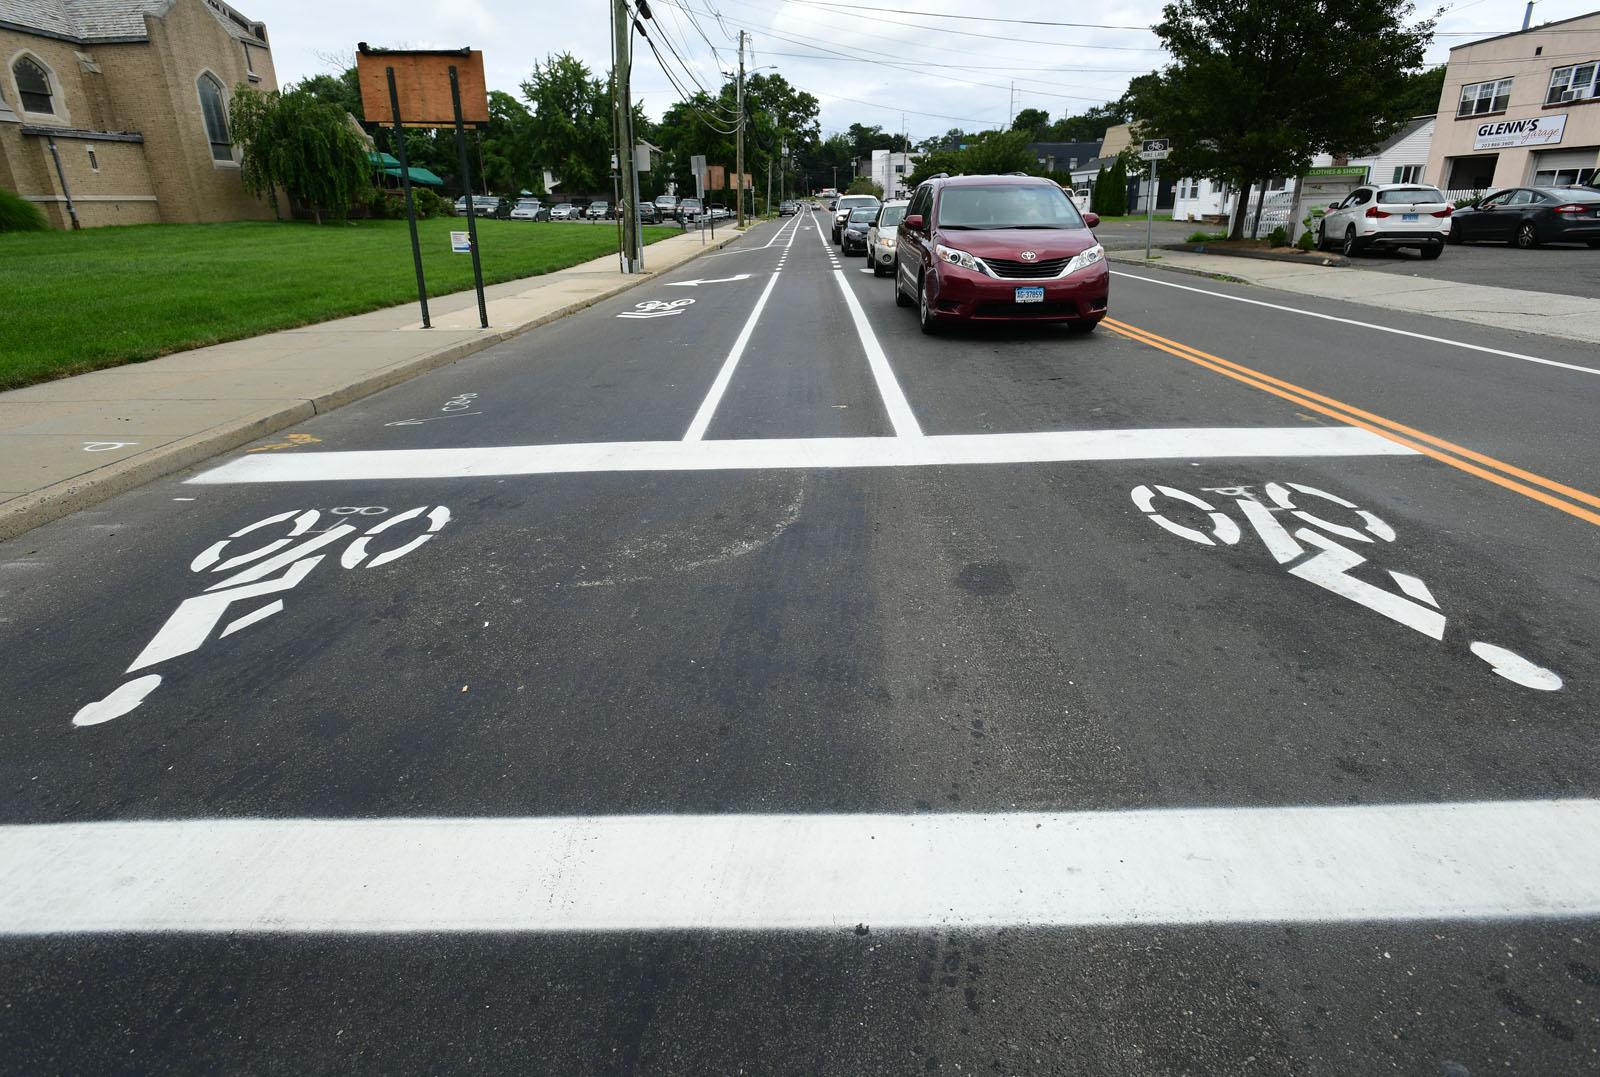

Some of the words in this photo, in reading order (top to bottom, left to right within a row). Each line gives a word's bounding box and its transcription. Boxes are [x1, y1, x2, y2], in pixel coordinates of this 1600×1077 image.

[1478, 119, 1539, 136] GLENN'S
[1520, 127, 1560, 144] Garage
[1309, 168, 1337, 176] CLOTHES
[1342, 167, 1364, 175] SHOES
